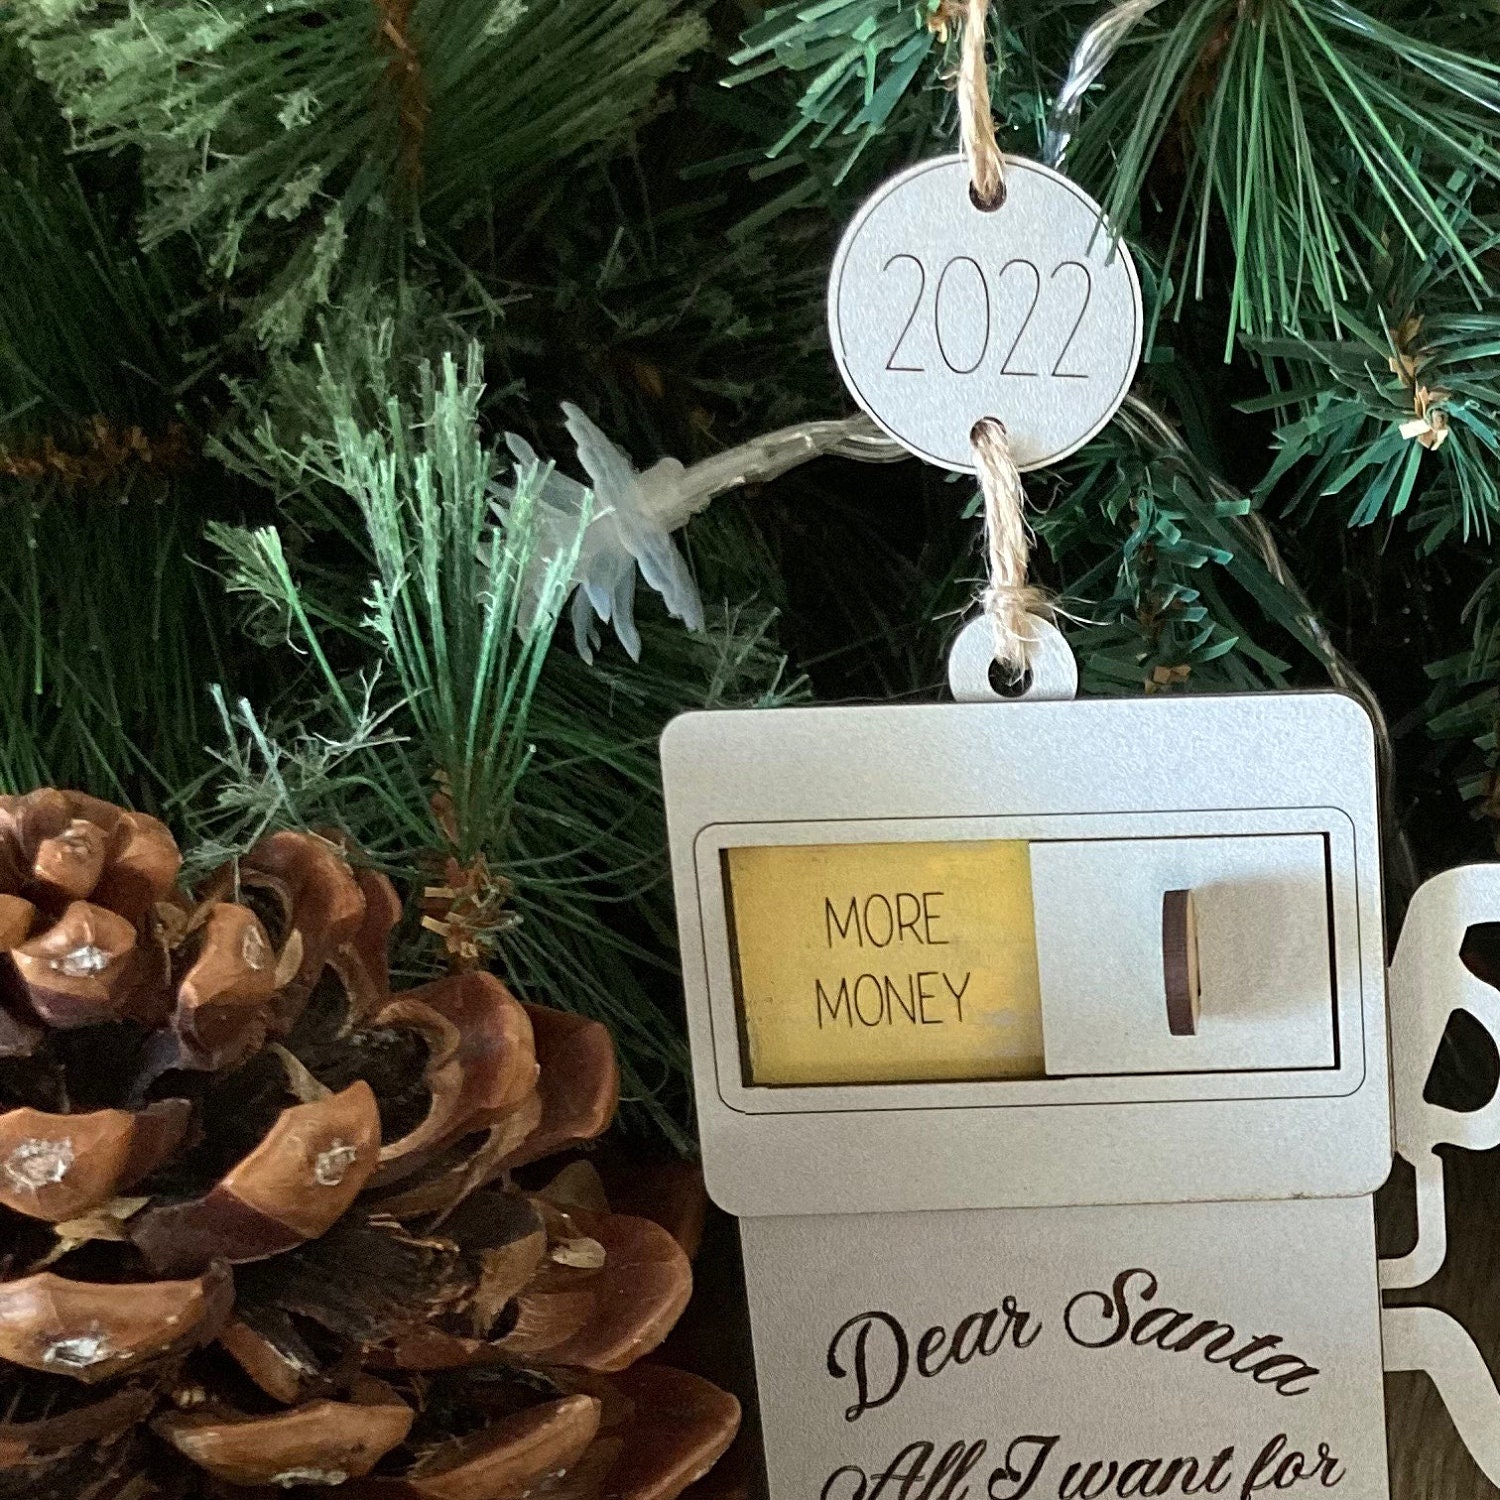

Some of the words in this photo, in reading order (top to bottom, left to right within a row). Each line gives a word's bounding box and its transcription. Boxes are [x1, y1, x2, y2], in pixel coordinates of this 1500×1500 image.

[883, 253, 1092, 379] 2022
[824, 891, 950, 949] MORE
[814, 970, 971, 1030] MONEY
[826, 1295, 1043, 1423] Dear
[1063, 1267, 1320, 1397] Santa
[1058, 1445, 1236, 1500] want
